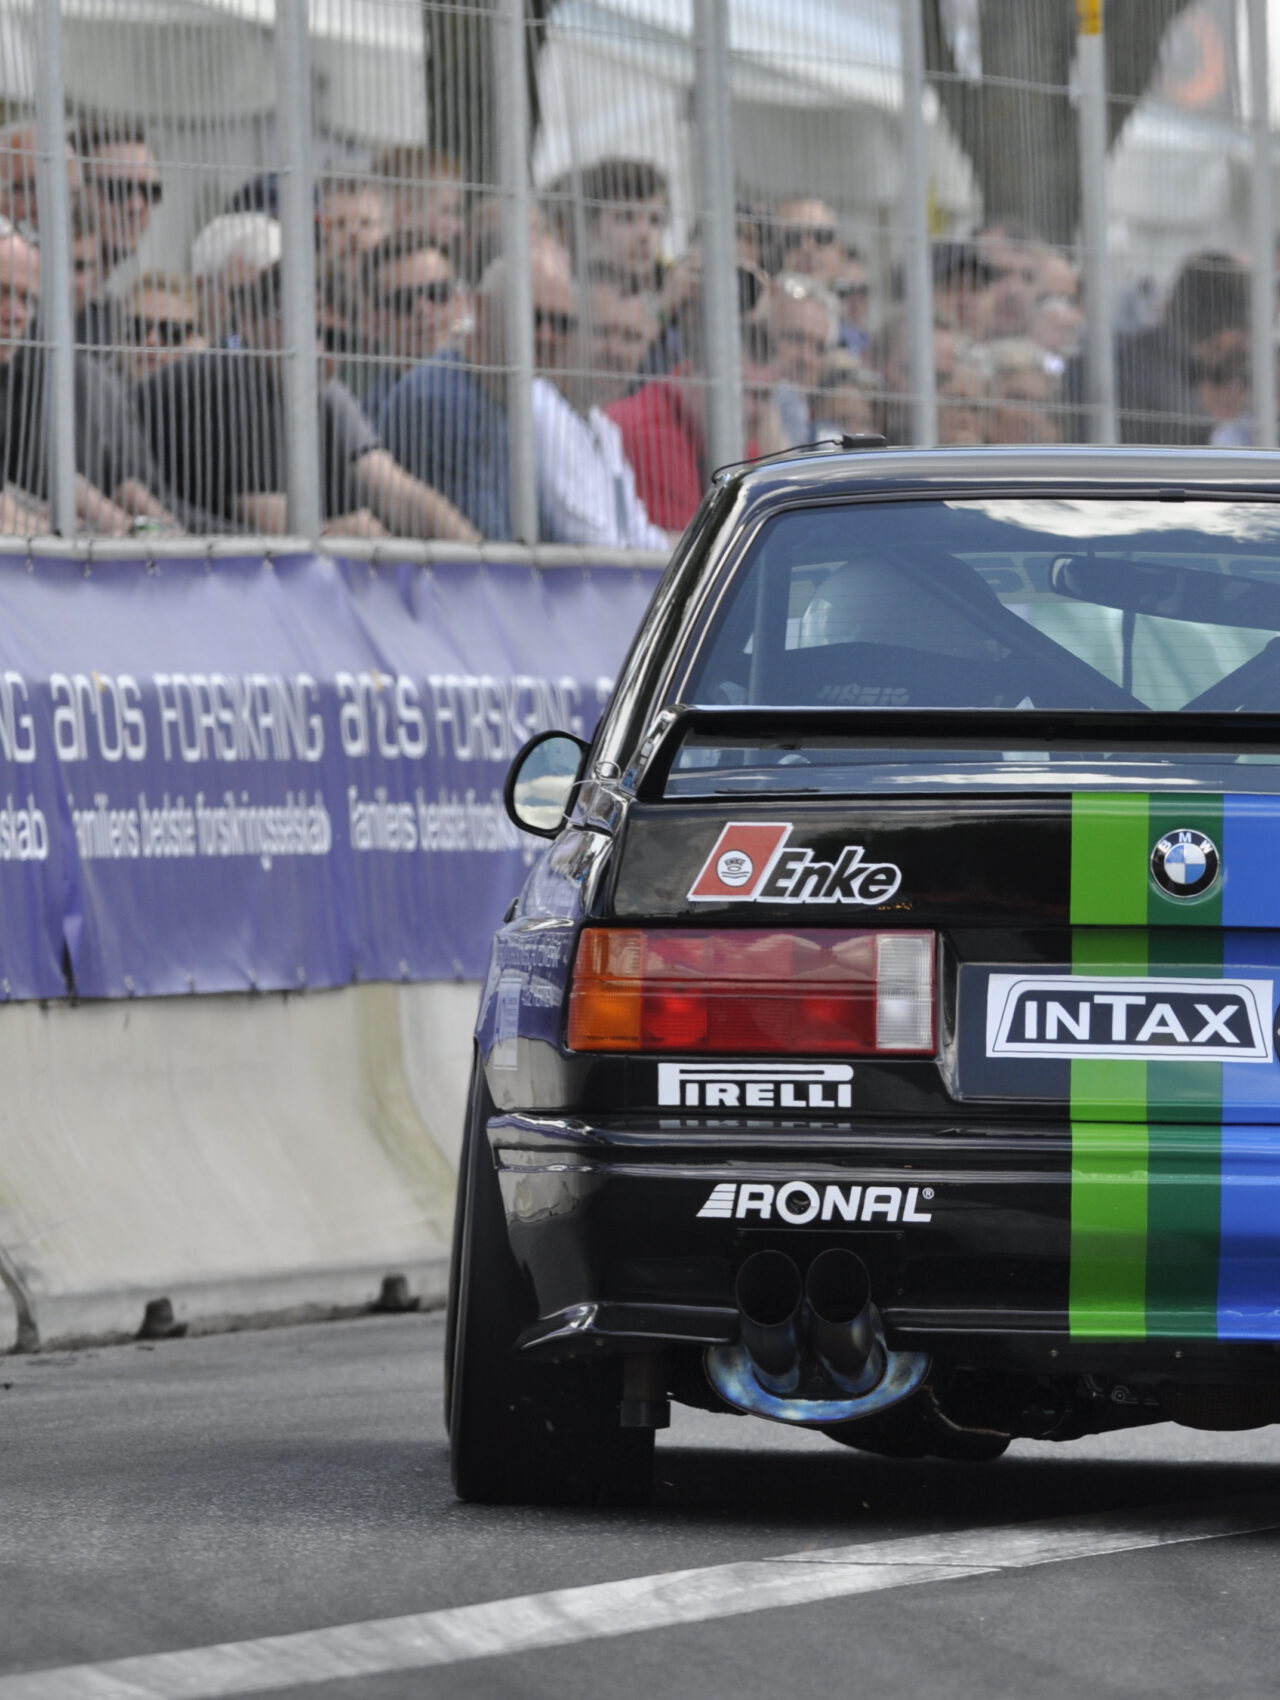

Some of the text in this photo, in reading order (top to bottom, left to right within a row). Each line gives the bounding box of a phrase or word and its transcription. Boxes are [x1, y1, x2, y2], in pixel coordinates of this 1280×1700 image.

[1157, 831, 1215, 855] BMW
[758, 846, 902, 902] Enke
[1024, 994, 1241, 1043] INTAX
[658, 1063, 854, 1107] PIRELLI
